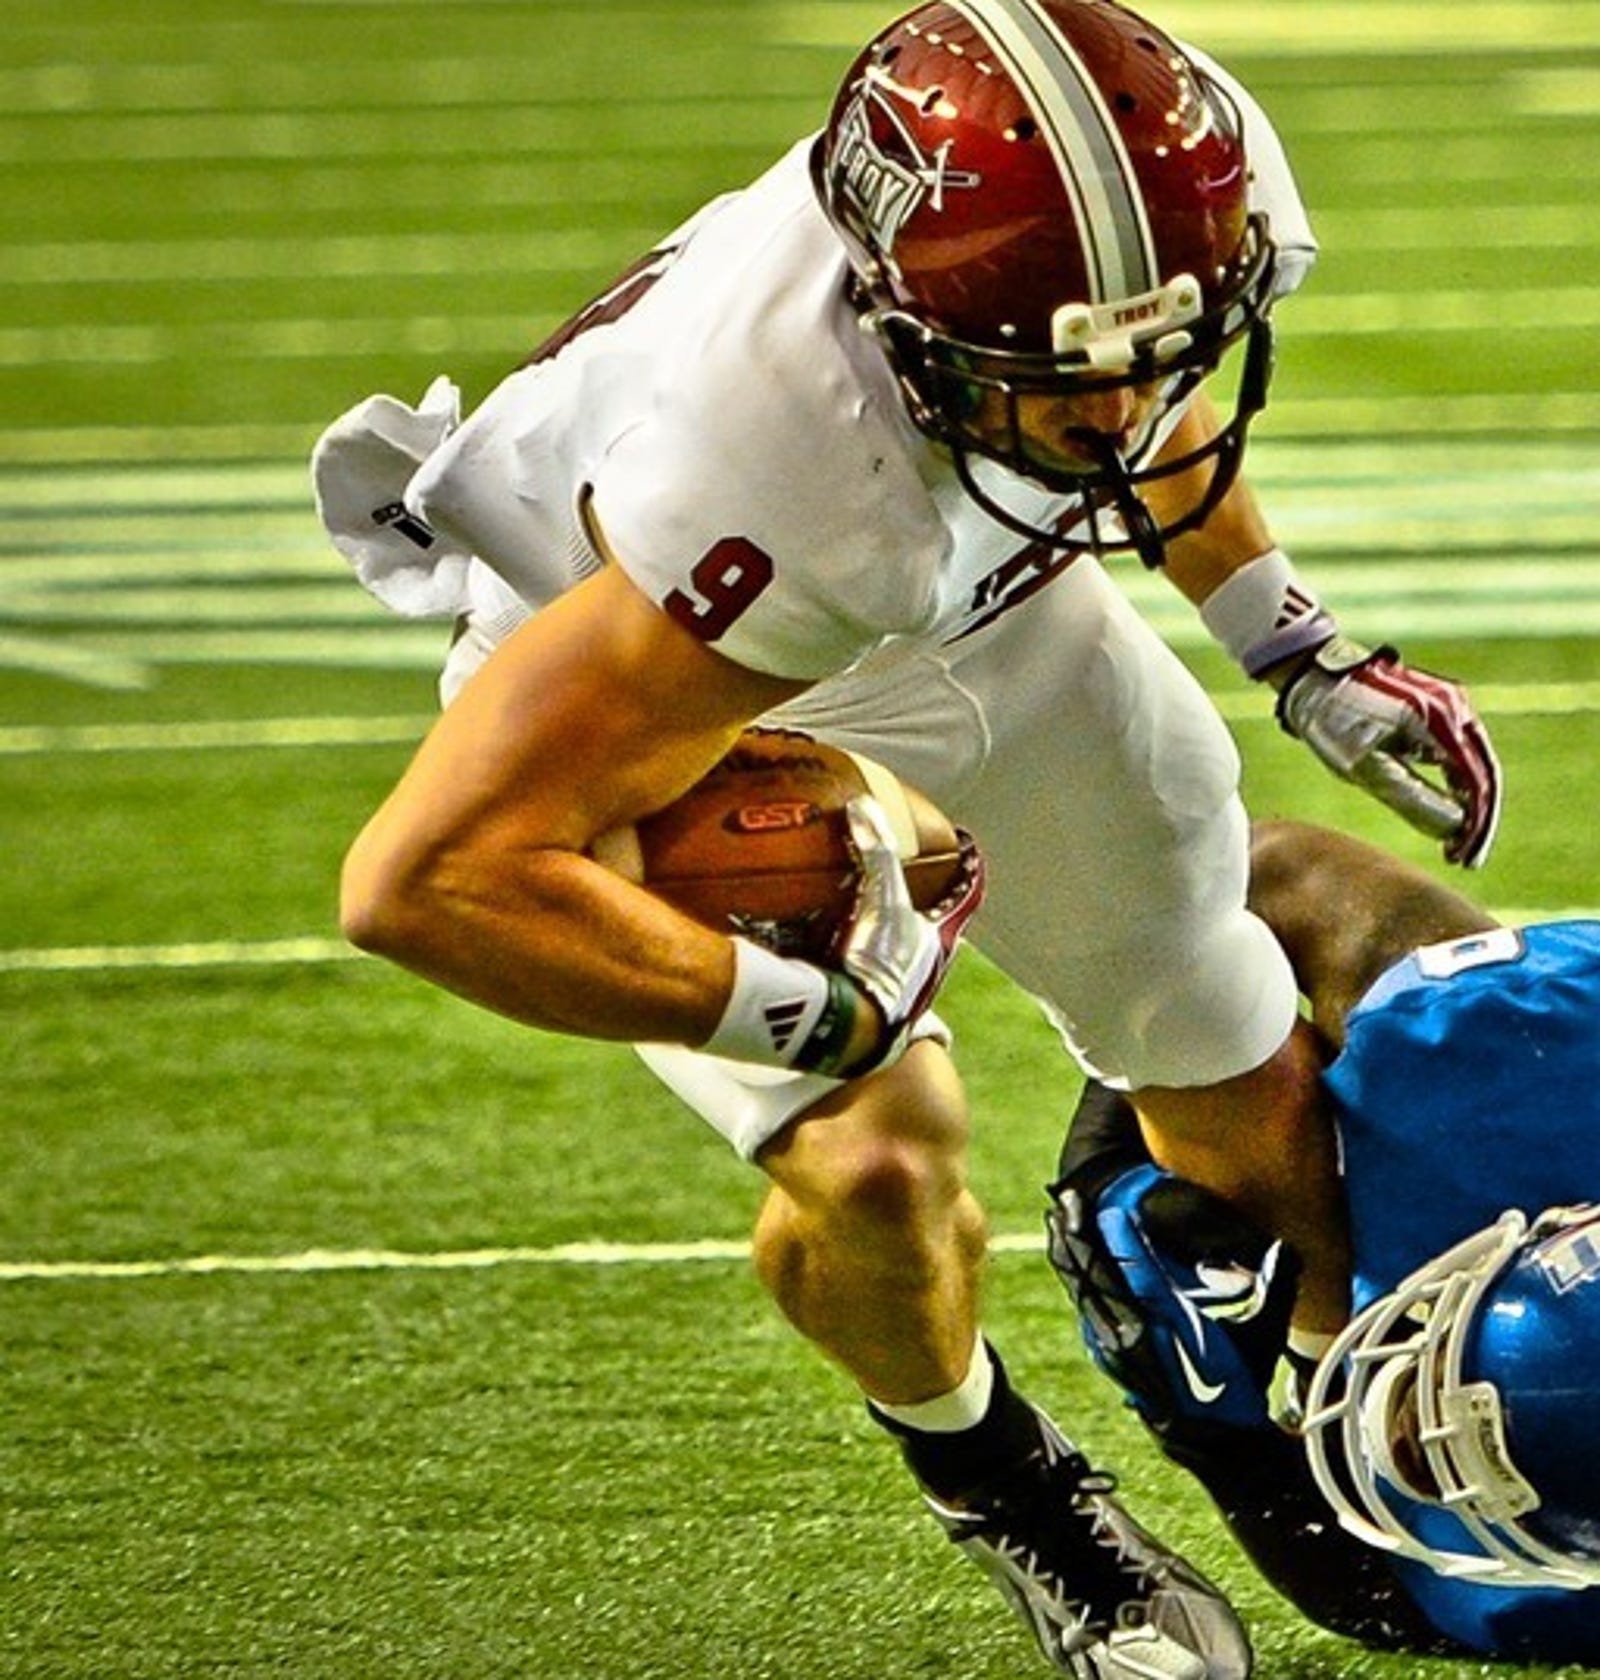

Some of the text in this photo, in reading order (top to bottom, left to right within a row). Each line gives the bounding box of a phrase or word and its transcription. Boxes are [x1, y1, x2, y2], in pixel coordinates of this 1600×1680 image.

[840, 119, 905, 226] TROY
[1112, 298, 1160, 326] TROY
[664, 537, 774, 641] 9
[740, 802, 810, 831] GST
